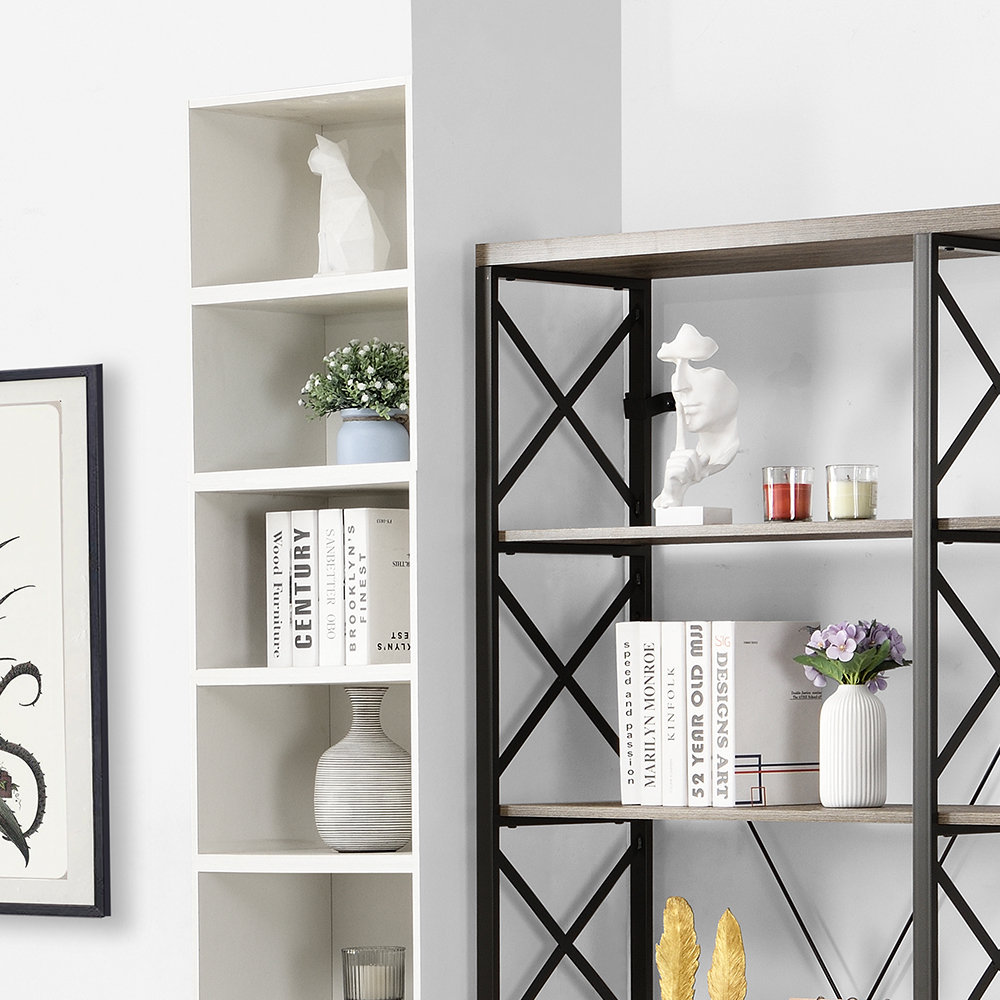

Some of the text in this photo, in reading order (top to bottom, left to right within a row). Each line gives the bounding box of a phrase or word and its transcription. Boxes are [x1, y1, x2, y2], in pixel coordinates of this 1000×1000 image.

[273, 530, 283, 659] Wood Furniture
[294, 528, 313, 649] CENTURY
[348, 525, 356, 652] BROOKLYN'S
[359, 553, 367, 623] FINEST
[624, 641, 635, 785] speed and passion
[643, 642, 656, 788] MARILYN MONROE
[667, 667, 675, 741] KINFOLK
[690, 664, 704, 708] OLD
[691, 714, 704, 767] YEAR
[716, 652, 729, 799] DESIGNS ART
[691, 773, 705, 798] 52
